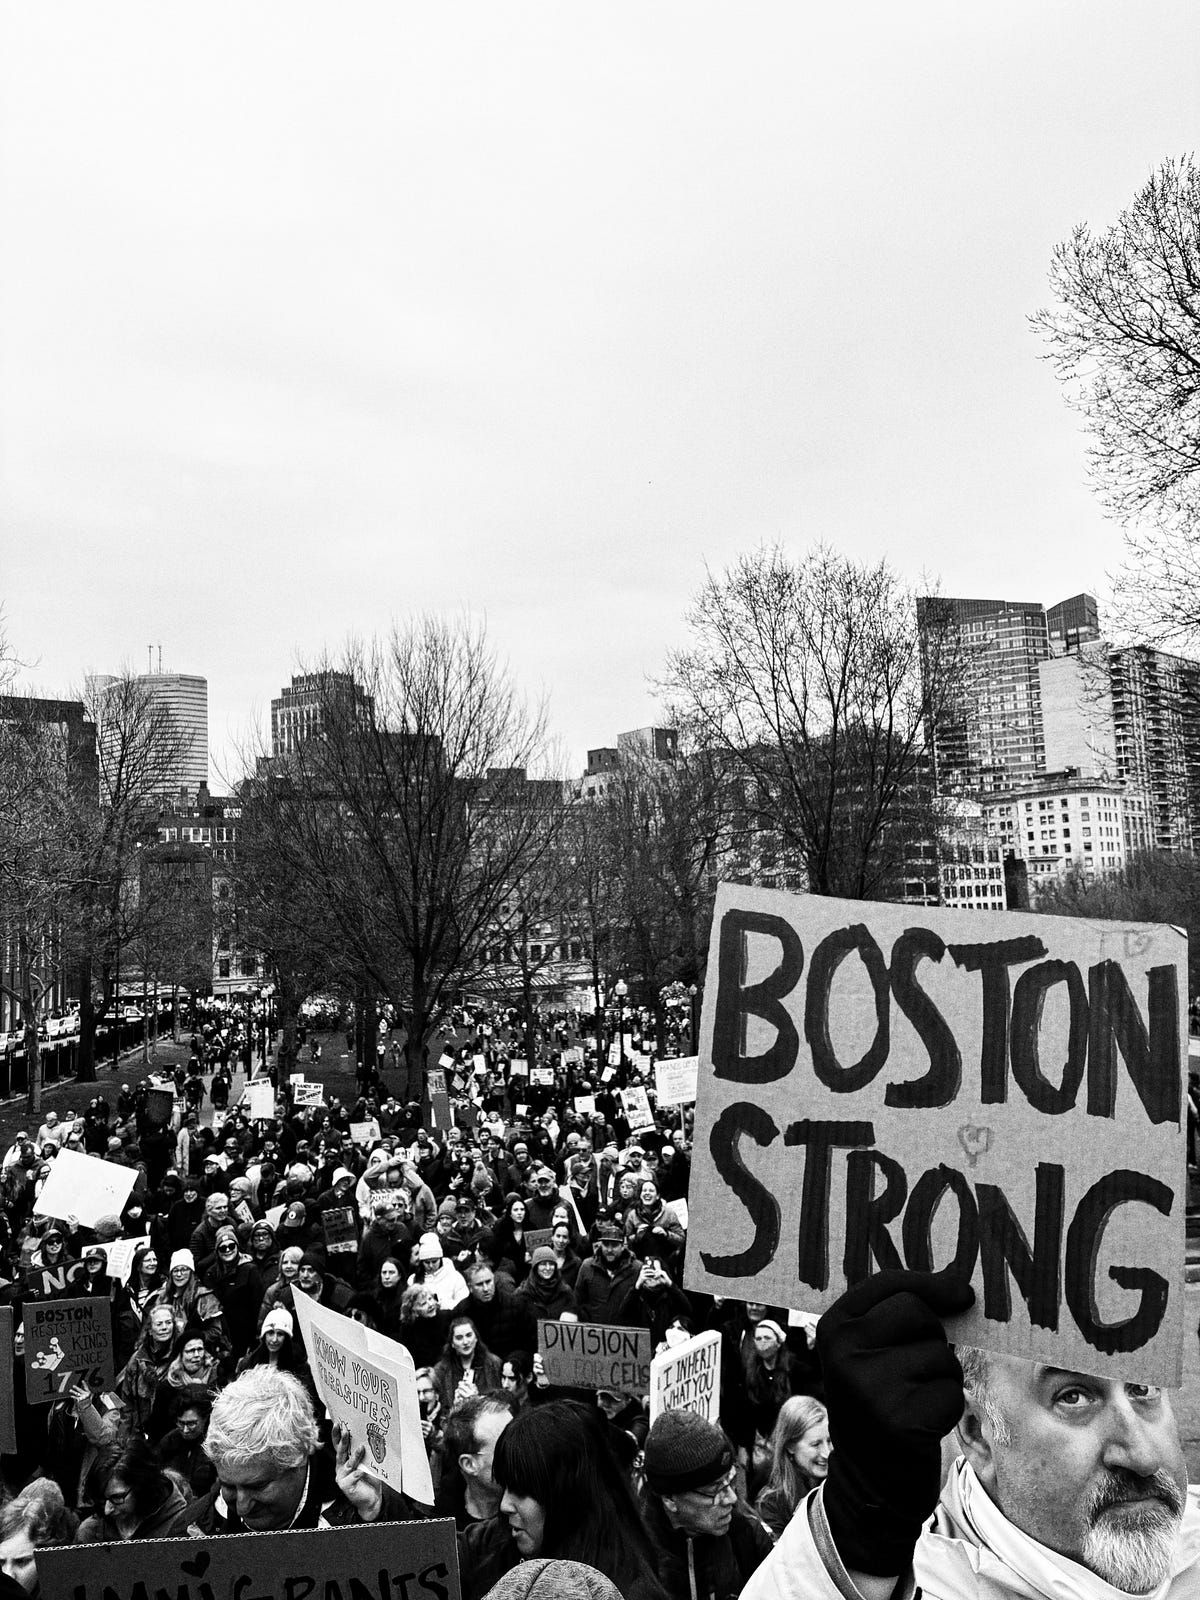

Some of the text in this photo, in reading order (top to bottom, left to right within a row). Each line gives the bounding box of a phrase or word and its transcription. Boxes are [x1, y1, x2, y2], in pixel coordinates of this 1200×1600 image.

[711, 909, 1182, 1131] BOSTON
[701, 1102, 1175, 1355] STRONG
[31, 1319, 100, 1338] RESISTING
[35, 1306, 93, 1324] BOSTON
[65, 1350, 105, 1368] SINCE
[72, 1333, 108, 1351] KINGS
[544, 1323, 639, 1359] DIVISION
[43, 1366, 104, 1395] 1776
[313, 1331, 393, 1408] KNOW YOUR
[574, 1358, 604, 1383] FOR
[663, 1341, 719, 1391] I INHERIT
[318, 1361, 392, 1430] PARASITES
[663, 1368, 714, 1412] WHAT YOU
